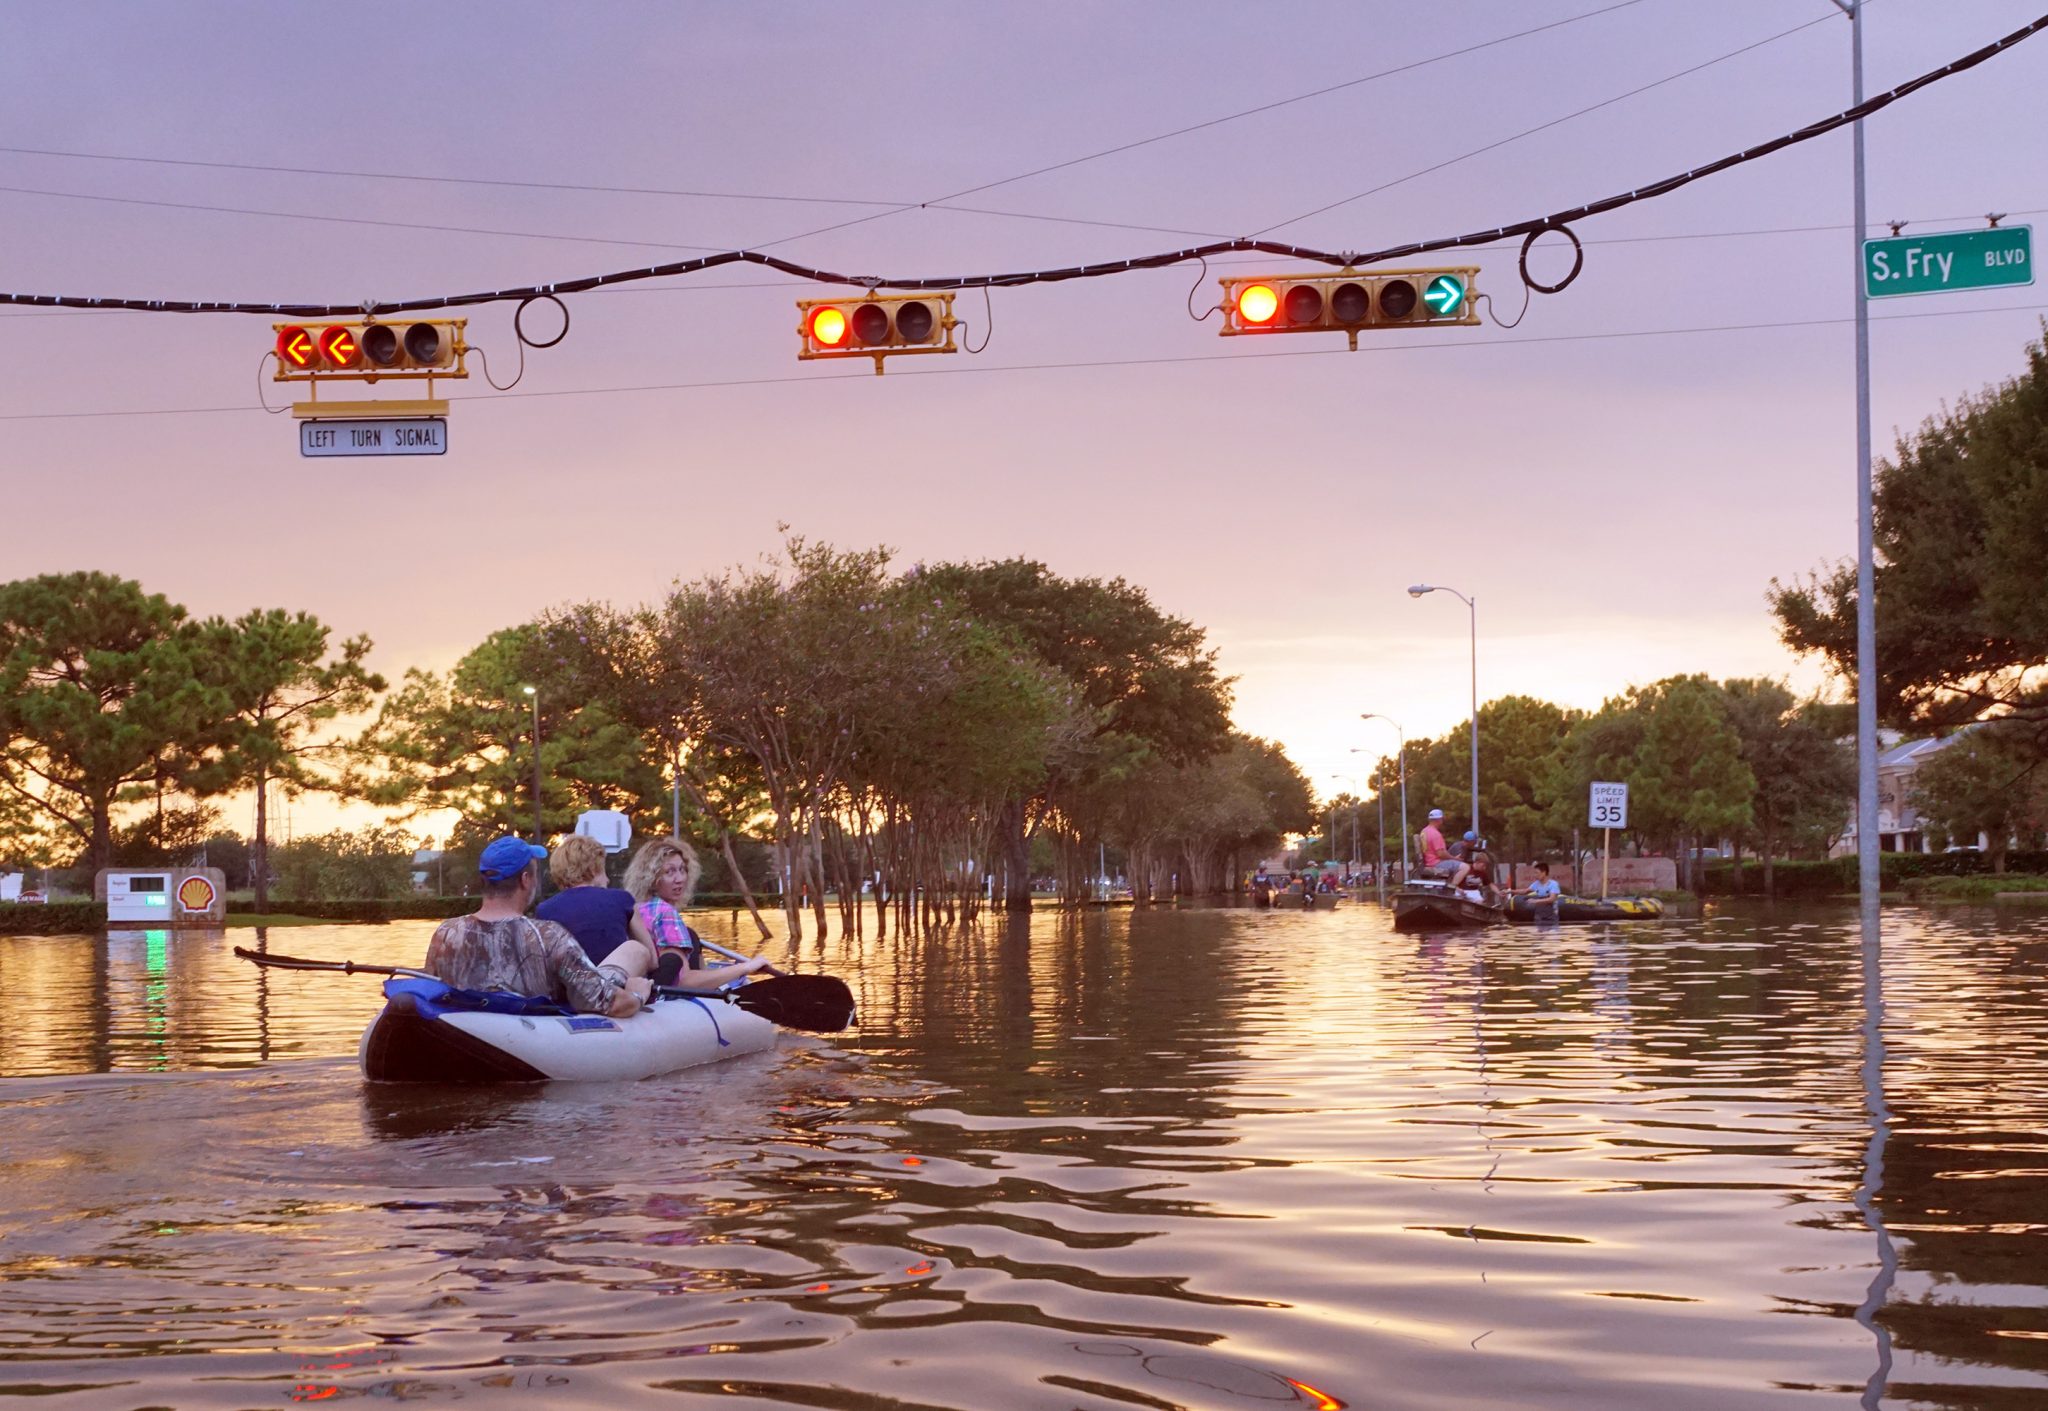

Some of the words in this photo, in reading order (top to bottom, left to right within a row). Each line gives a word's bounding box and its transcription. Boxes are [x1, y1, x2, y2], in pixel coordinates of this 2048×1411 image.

[1872, 251, 1900, 281] S.
[1906, 248, 1954, 282] Fry
[1985, 249, 2025, 266] BLVD
[308, 430, 336, 447] LEFT
[350, 429, 381, 447] TURN
[395, 428, 438, 446] SIGNAL
[1594, 787, 1625, 796] SPEED
[1595, 806, 1621, 822] 35
